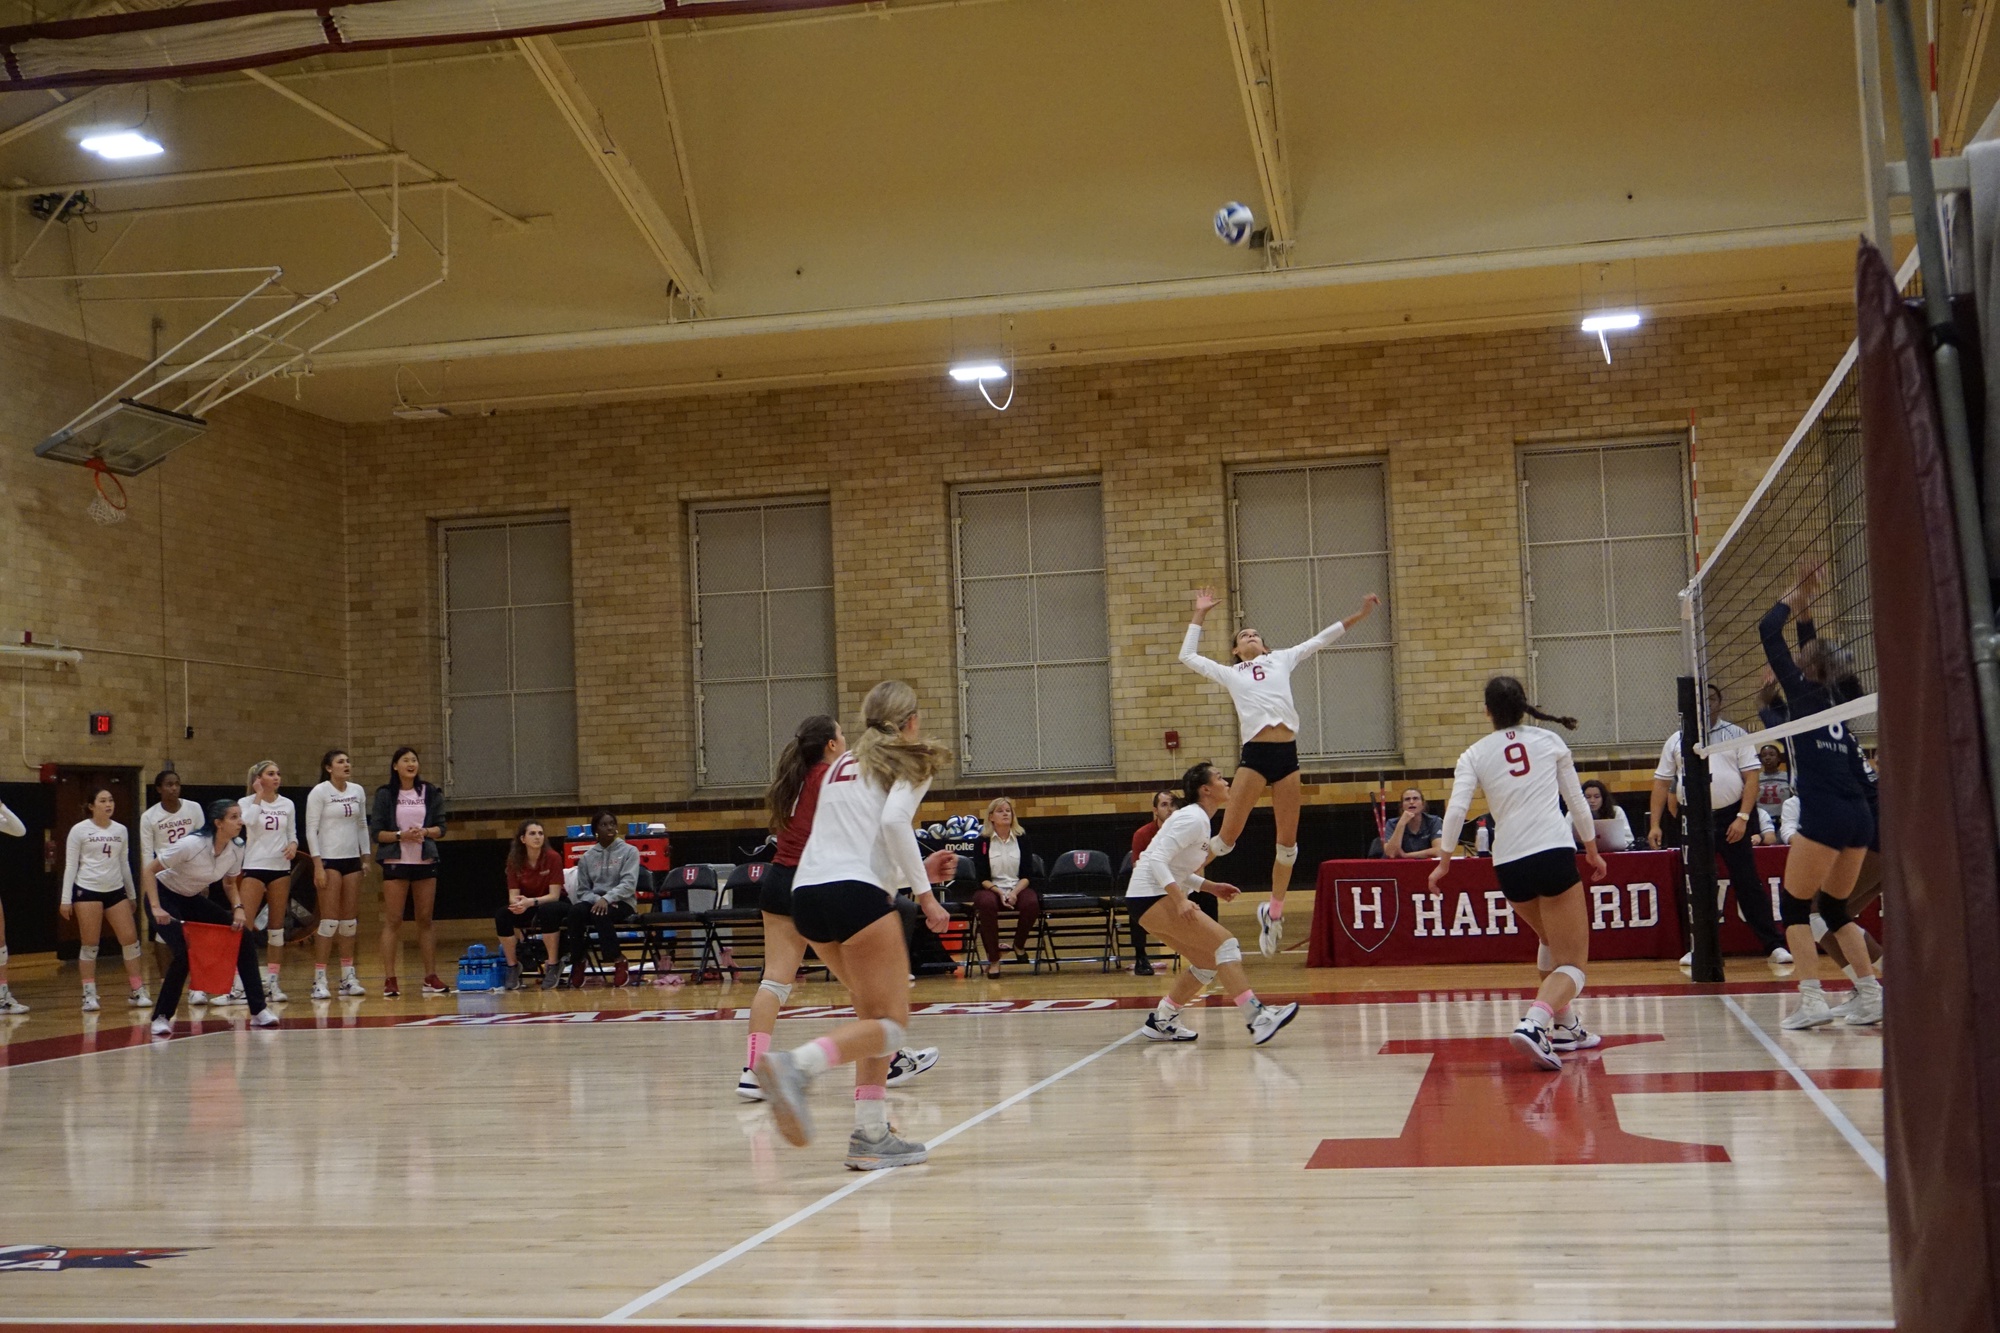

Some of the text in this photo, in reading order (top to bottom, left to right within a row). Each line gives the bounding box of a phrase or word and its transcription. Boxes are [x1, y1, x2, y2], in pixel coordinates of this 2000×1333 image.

[1252, 665, 1265, 681] 6
[1504, 742, 1530, 777] 9
[398, 798, 426, 806] ARVARD
[344, 804, 352, 818] 11
[158, 818, 192, 830] HARVARD
[265, 816, 279, 831] 21
[167, 827, 186, 844] 22
[102, 843, 112, 858] 4
[945, 842, 975, 851] molte
[1077, 854, 1086, 864] H
[686, 868, 696, 880] H
[751, 866, 761, 877] H
[1351, 886, 1385, 930] H
[1412, 882, 1658, 936] HARRD
